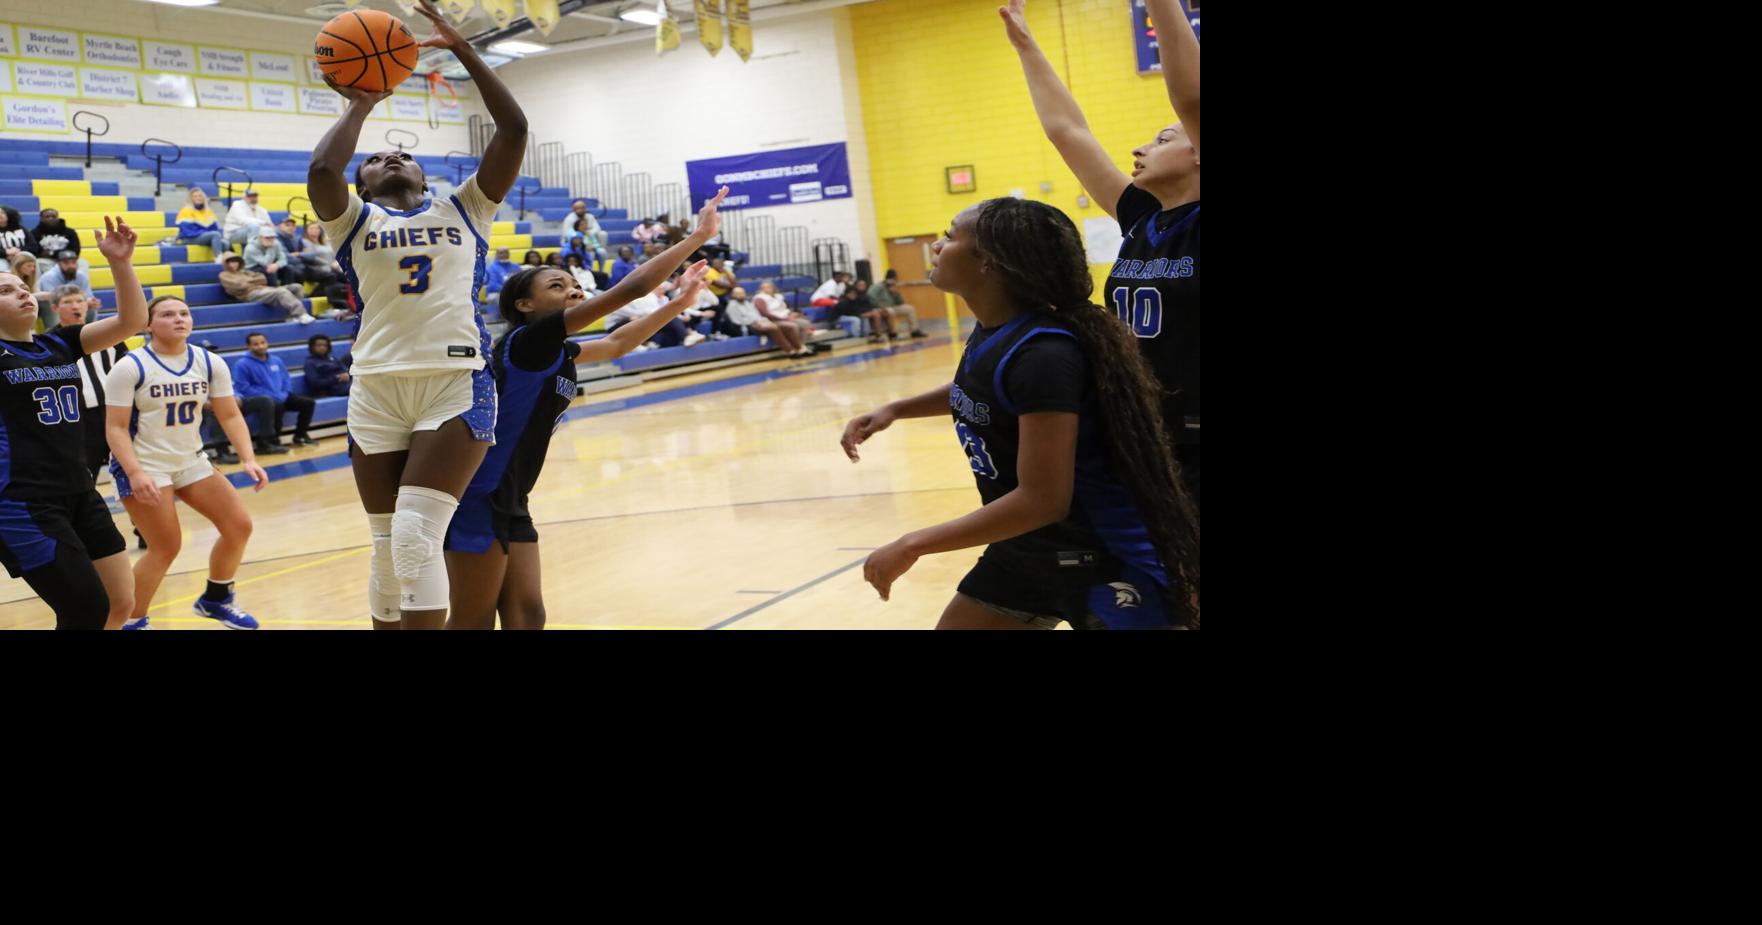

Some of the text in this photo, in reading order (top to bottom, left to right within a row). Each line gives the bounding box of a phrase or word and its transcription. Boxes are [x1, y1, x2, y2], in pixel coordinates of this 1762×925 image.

[30, 32, 69, 44] Barefoot
[86, 39, 138, 52] Myrtle Beach
[26, 44, 75, 56] RV Center
[86, 50, 138, 63] Orthodontics
[28, 116, 66, 129] Detailing
[363, 226, 463, 252] CHIEFS
[398, 254, 434, 295] 3
[1112, 286, 1163, 338] 10
[149, 381, 209, 398] CHIEFS
[32, 385, 80, 425] 30
[165, 400, 198, 427] 10
